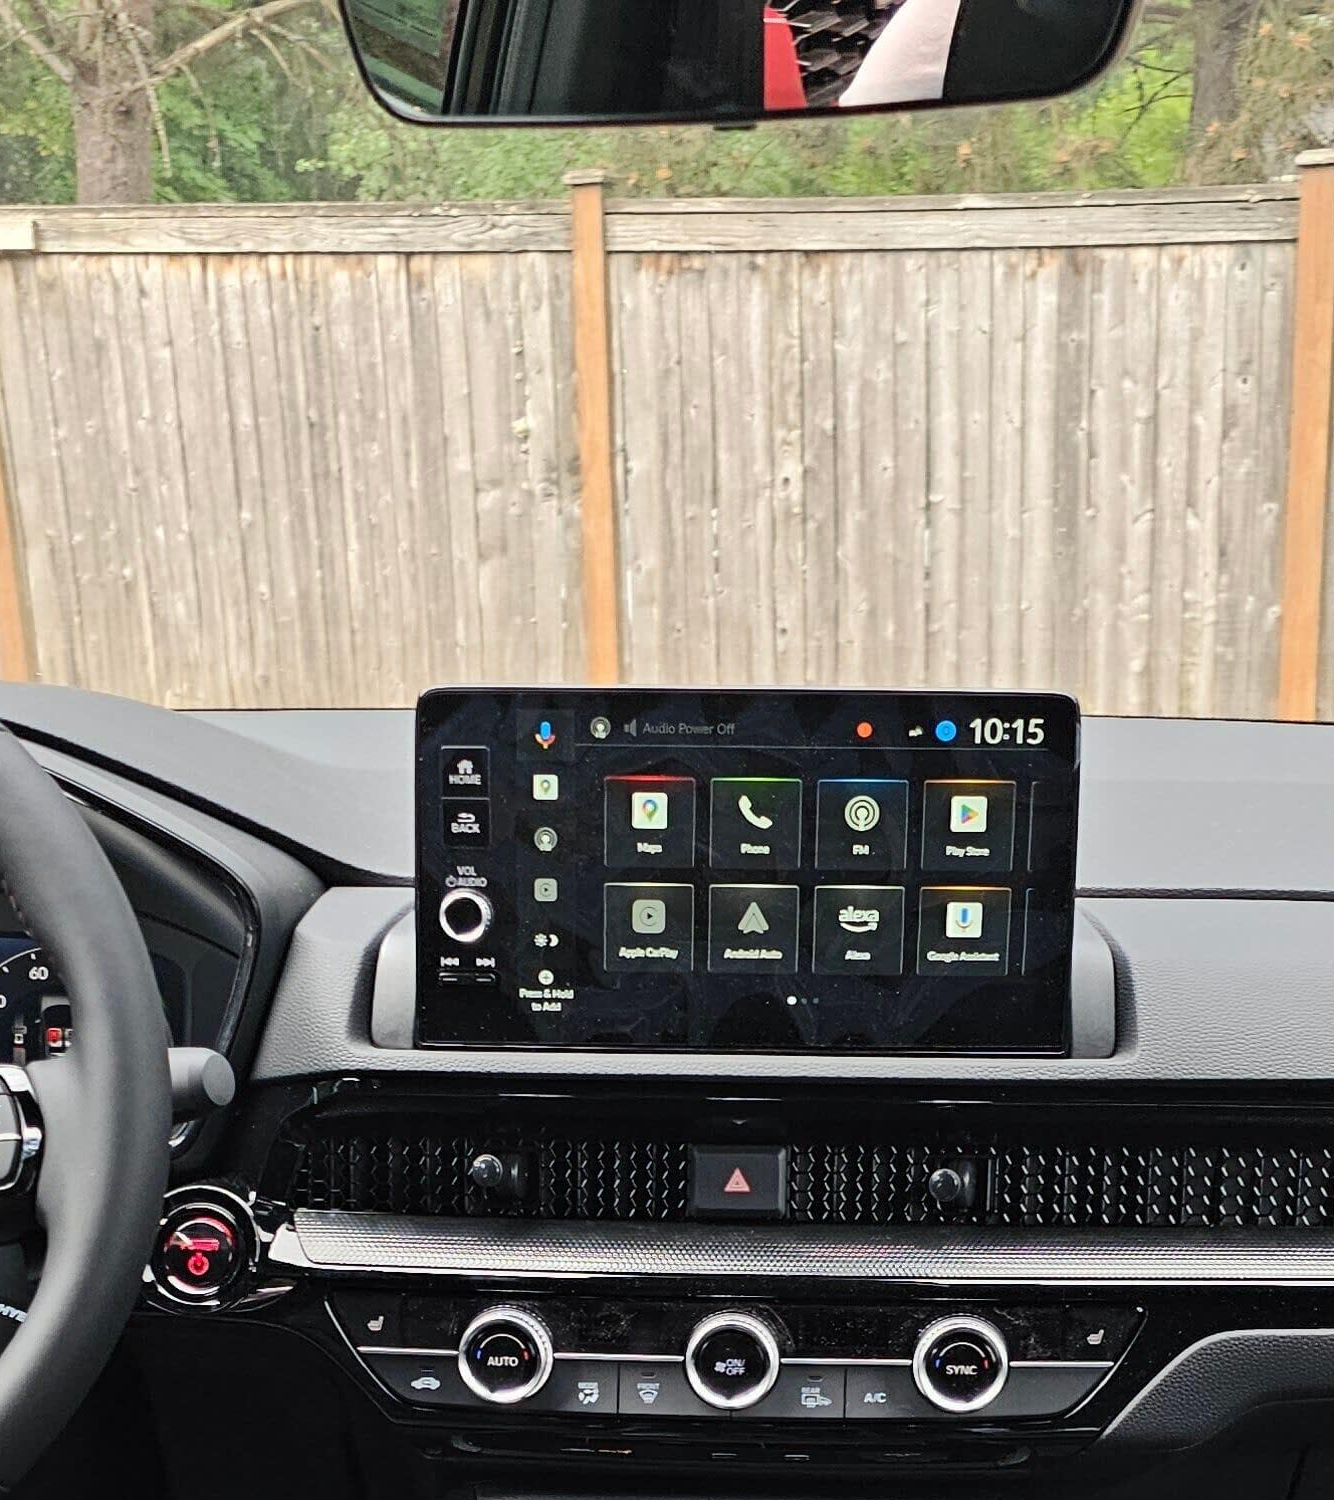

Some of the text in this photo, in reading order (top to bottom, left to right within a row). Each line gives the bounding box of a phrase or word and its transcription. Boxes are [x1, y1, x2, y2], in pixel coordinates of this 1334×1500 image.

[642, 722, 736, 735] Audio Power Off
[969, 717, 1045, 745] 10:15
[448, 774, 482, 785] HOME
[450, 823, 480, 833] BACK
[456, 866, 477, 876] VOL
[838, 905, 880, 923] alexa
[28, 966, 49, 981] 60
[531, 1002, 542, 1011] to
[487, 1356, 519, 1367] AUTO
[726, 1367, 746, 1376] OFF
[945, 1365, 979, 1376] SYNC
[863, 1392, 887, 1404] A/C
